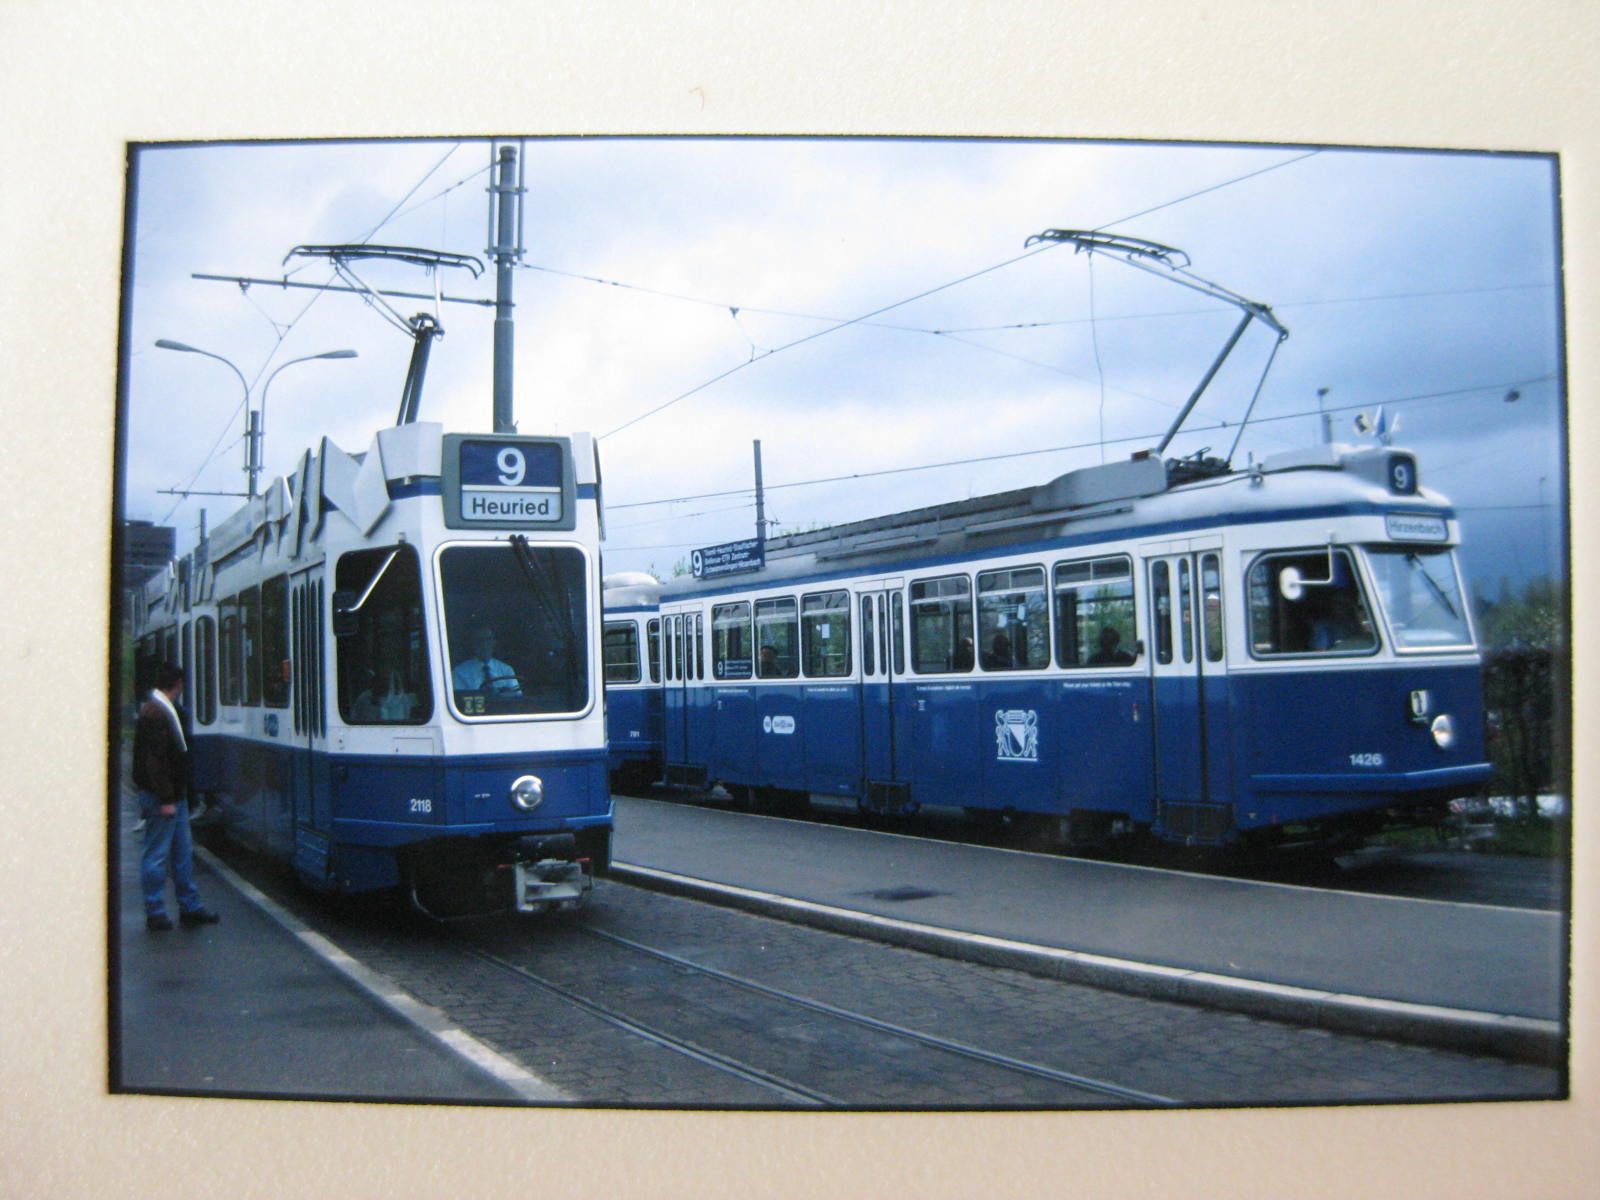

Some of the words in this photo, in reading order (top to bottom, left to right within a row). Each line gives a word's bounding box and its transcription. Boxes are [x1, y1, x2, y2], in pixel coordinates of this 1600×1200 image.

[497, 447, 526, 486] 9
[1393, 465, 1408, 489] 9
[472, 497, 549, 515] Heuried
[693, 551, 703, 576] 9
[717, 661, 724, 676] 9
[1349, 752, 1384, 767] 1426
[411, 799, 431, 813] 2118
